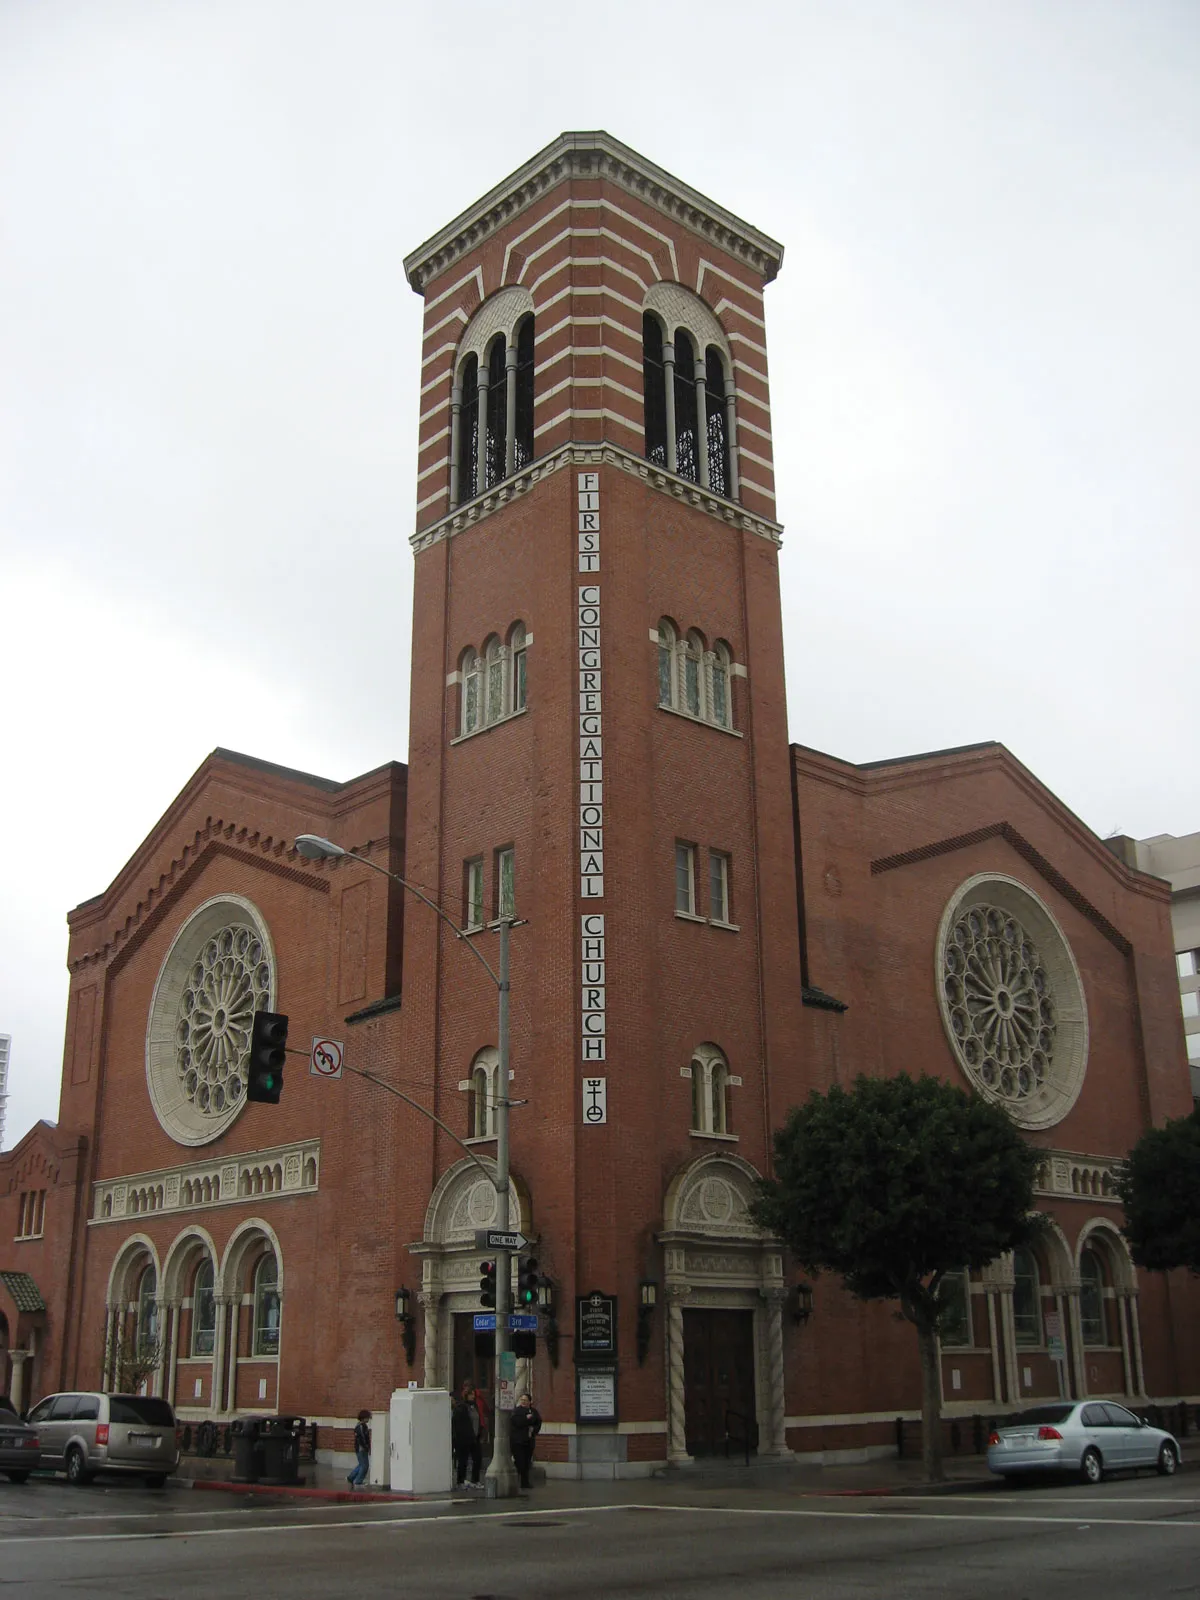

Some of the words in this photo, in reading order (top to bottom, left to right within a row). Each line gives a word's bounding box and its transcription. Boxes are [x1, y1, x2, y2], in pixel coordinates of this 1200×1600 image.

[581, 474, 598, 571] FIRST
[580, 587, 601, 896] CONGREGATIONAL
[584, 916, 602, 1059] CHURCH
[491, 1235, 503, 1244] ONE
[505, 1236, 517, 1245] WAY
[475, 1318, 489, 1327] Cedar
[511, 1318, 522, 1326] 3rd
